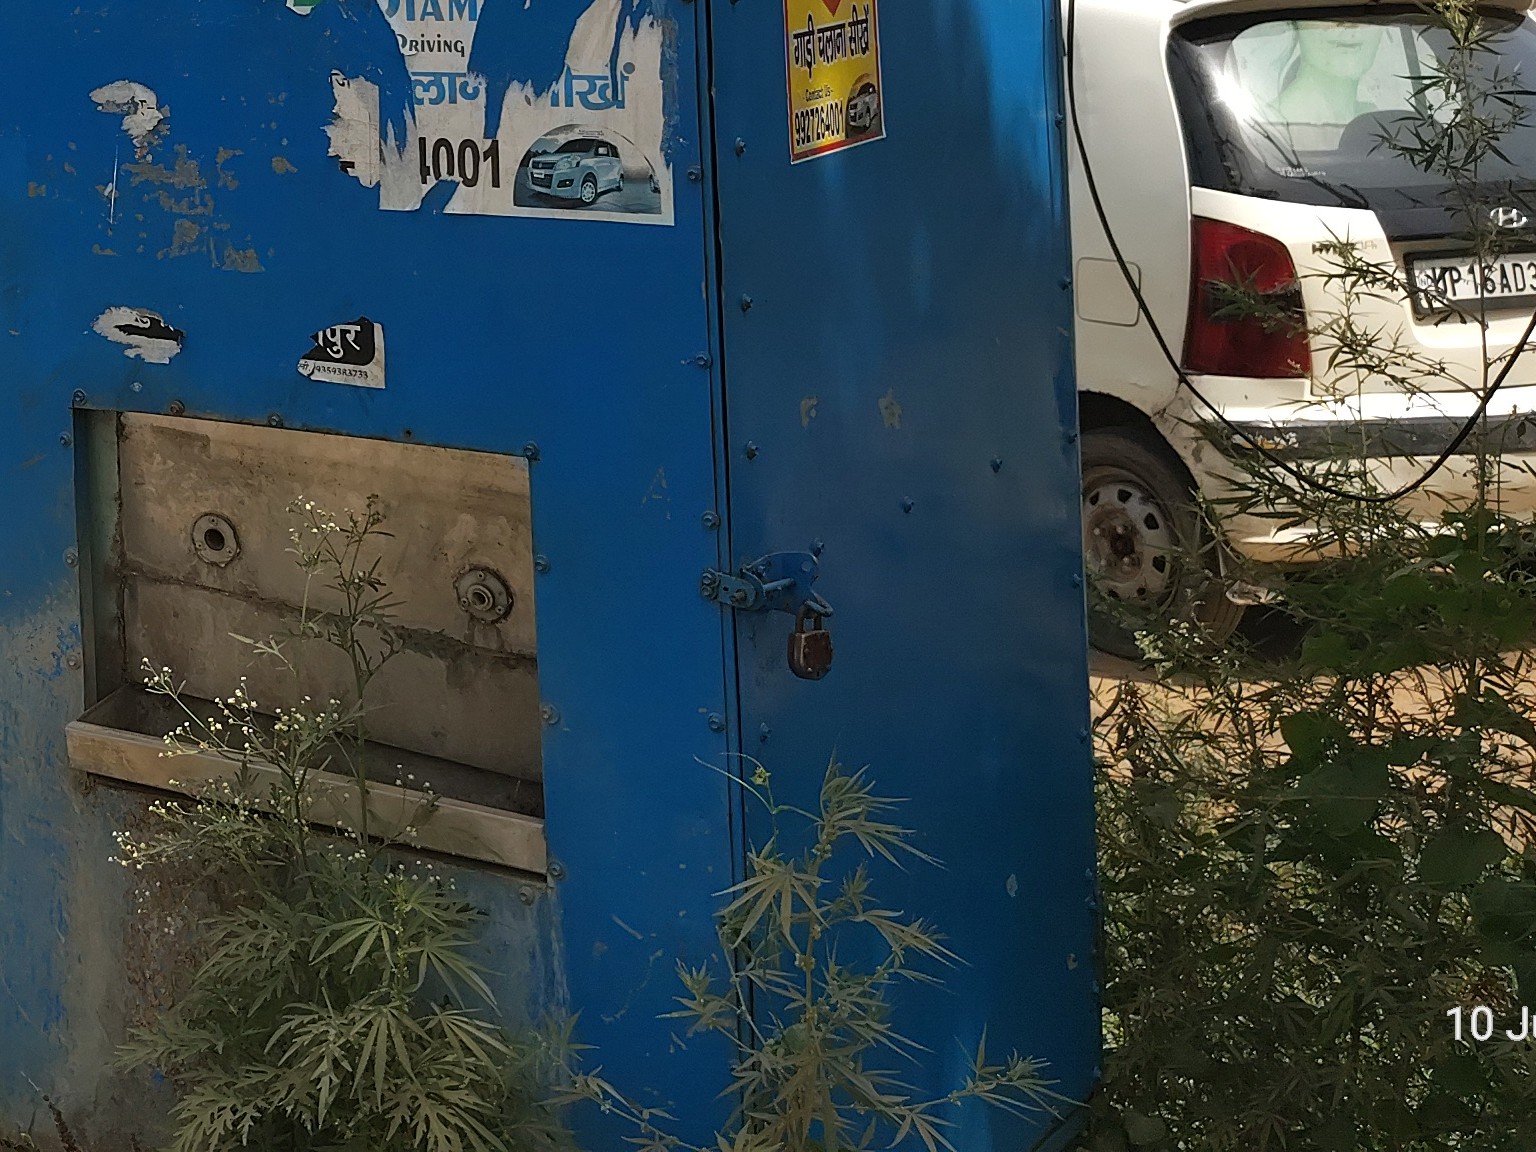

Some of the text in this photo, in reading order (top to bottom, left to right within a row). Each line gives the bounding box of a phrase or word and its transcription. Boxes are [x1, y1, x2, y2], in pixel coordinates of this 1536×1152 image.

[817, 23, 846, 64] चलाना
[848, 3, 870, 56] सीखें
[795, 100, 844, 146] 9927264001
